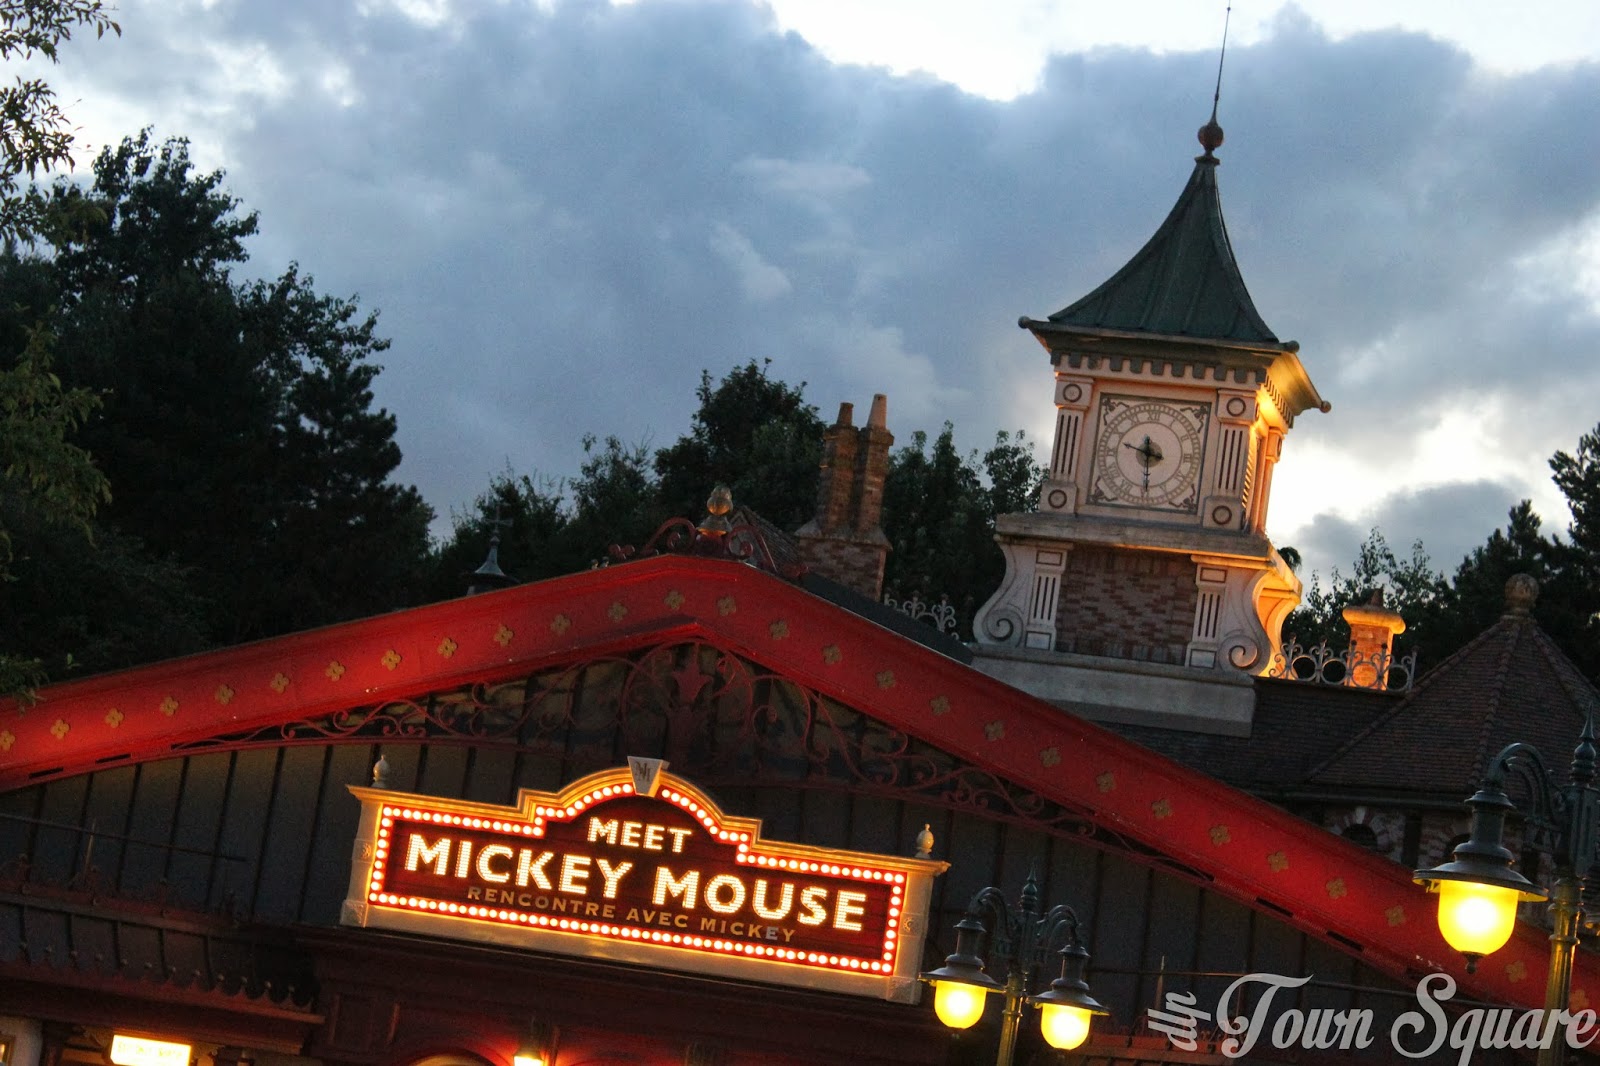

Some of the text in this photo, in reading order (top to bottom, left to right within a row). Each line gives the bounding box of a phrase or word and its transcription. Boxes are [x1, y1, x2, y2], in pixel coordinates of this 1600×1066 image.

[588, 816, 693, 854] MEET
[404, 833, 868, 932] MICKEY MOUSE
[467, 885, 796, 943] RENCONTRE AVEC MICKEY
